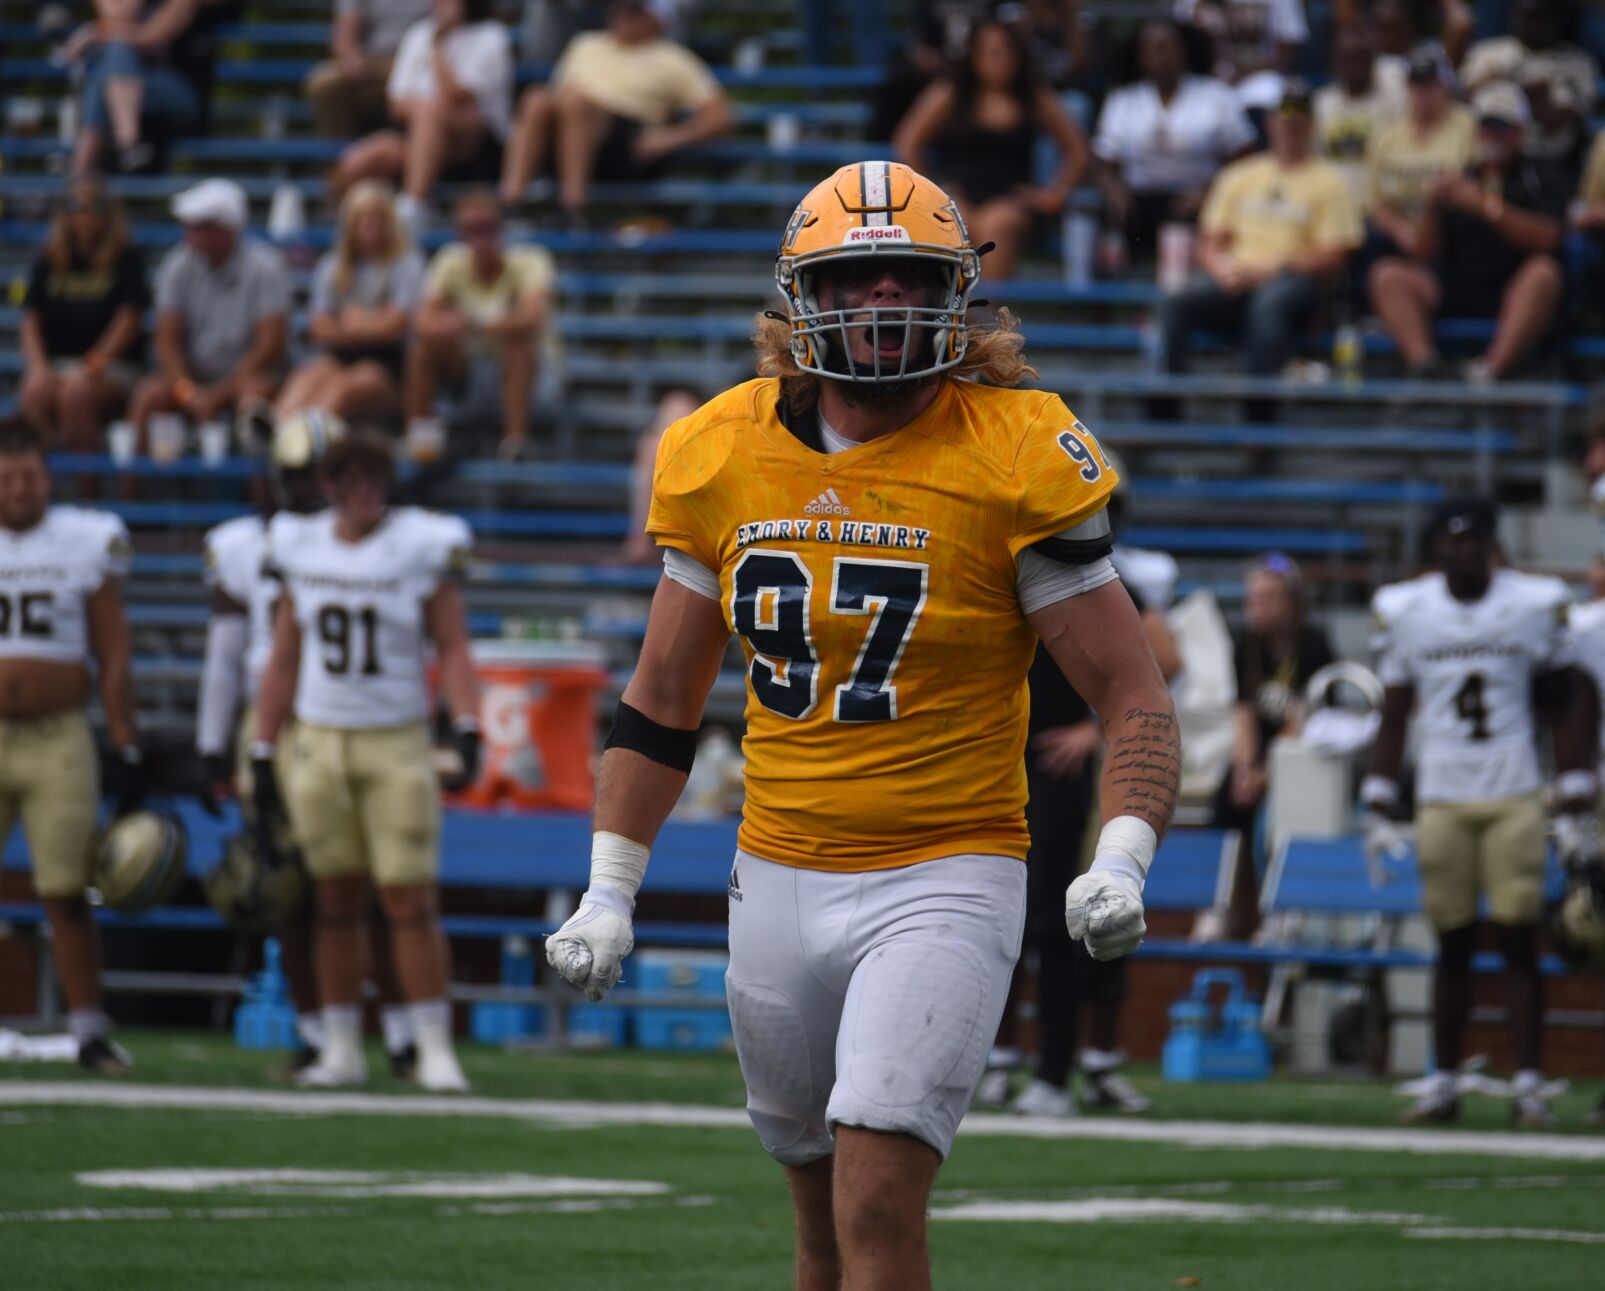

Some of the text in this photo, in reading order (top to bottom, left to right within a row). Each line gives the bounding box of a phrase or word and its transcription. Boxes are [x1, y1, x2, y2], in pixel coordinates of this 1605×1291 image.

[850, 227, 902, 241] Riddell
[736, 519, 930, 549] EMORY & HENRY
[804, 502, 851, 515] adidas
[316, 602, 384, 677] 91
[730, 547, 930, 724] 97
[1451, 669, 1495, 742] 4
